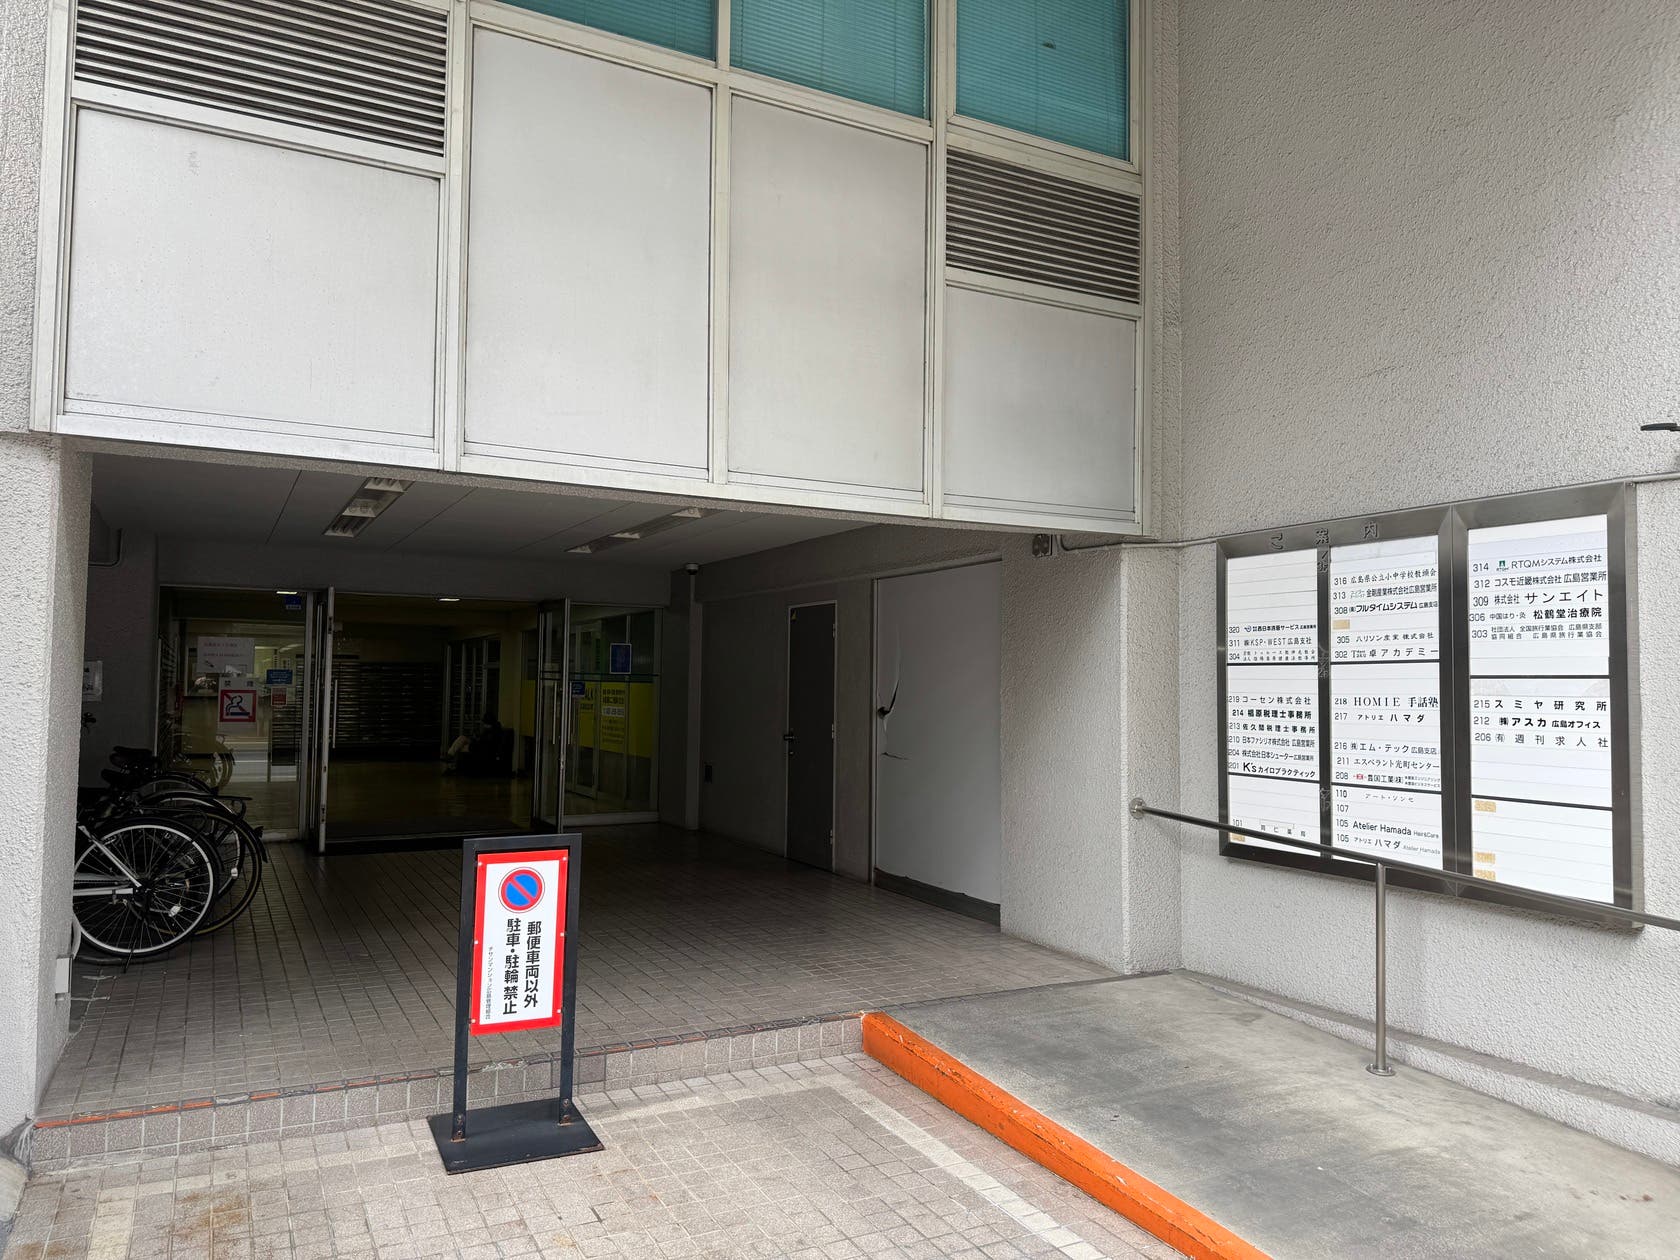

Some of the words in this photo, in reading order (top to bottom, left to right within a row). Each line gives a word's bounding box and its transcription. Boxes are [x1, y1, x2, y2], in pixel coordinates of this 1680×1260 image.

[1473, 563, 1489, 572] 314
[1511, 554, 1602, 569] RTQMシステム株式会社
[1334, 577, 1347, 585] 316
[1474, 580, 1490, 588] 312
[1494, 575, 1562, 587] コスモ近畿株式会社
[1563, 570, 1607, 583] 広島営業所
[1333, 592, 1346, 600] 313
[1473, 597, 1489, 606] 309
[1494, 594, 1520, 605] 株式会社
[1524, 589, 1603, 604] サンエイト
[1334, 606, 1348, 615] 308
[1533, 607, 1602, 620] 松鶴堂治療院
[1471, 630, 1488, 638] 303
[1229, 639, 1240, 647] 311
[1336, 636, 1350, 644] 305
[1334, 650, 1348, 658] 302
[1369, 647, 1439, 657] 卓アカデミー
[1242, 696, 1311, 705] コーセン株式会社
[1353, 696, 1401, 707] HOMIE
[1408, 696, 1439, 708] 手話塾
[1473, 700, 1490, 708] 215
[1495, 699, 1607, 711] スミヤ研究所
[1334, 712, 1348, 720] 217
[1390, 713, 1425, 723] ハマダ
[1473, 716, 1490, 725] 212
[1551, 720, 1601, 729] 広島オフィス
[1242, 723, 1316, 734] 佐久間税理士事務所
[1474, 733, 1491, 741] 206
[1334, 742, 1348, 750] 216
[1336, 757, 1350, 765] 211
[1258, 766, 1316, 778] カイロプラクティック
[1336, 789, 1348, 798] 110
[1336, 804, 1349, 812] 107
[1336, 819, 1348, 827] 105
[1352, 820, 1378, 831] Atelier
[1380, 824, 1412, 835] Hamada
[1336, 834, 1349, 842] 105
[1374, 839, 1401, 849] ハマダ
[503, 918, 521, 1015] 駐車・駐輪禁止
[524, 920, 542, 1008] 郵便車両以外
